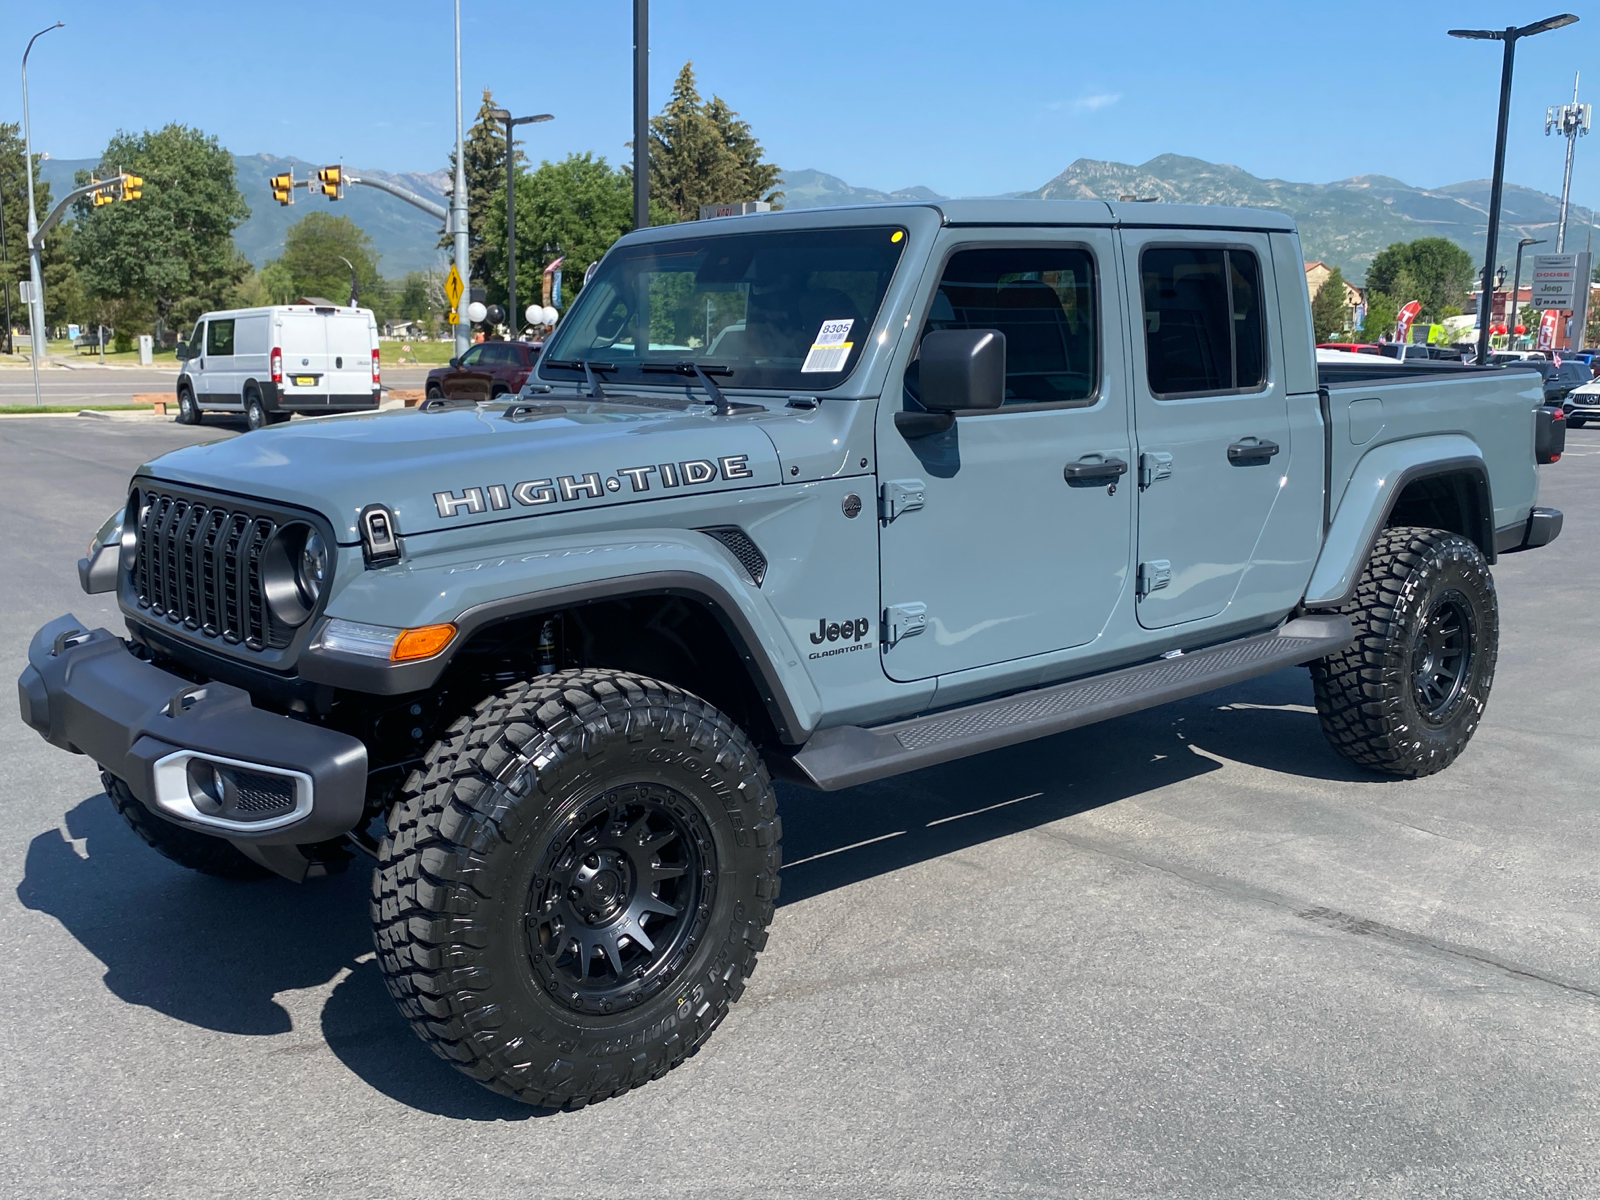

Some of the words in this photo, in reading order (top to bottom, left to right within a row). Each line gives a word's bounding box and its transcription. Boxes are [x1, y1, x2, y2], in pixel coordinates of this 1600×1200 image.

[1541, 284, 1563, 293] Jeep
[823, 323, 851, 334] 8305
[433, 472, 604, 518] HIGH
[617, 454, 753, 492] TIDE
[808, 644, 863, 660] GLADIATOR
[809, 617, 869, 645] Jeep
[630, 746, 703, 772] TOYO
[700, 767, 751, 848] TIRES
[707, 899, 746, 985] OPEN
[586, 982, 706, 1058] COUNTRY
